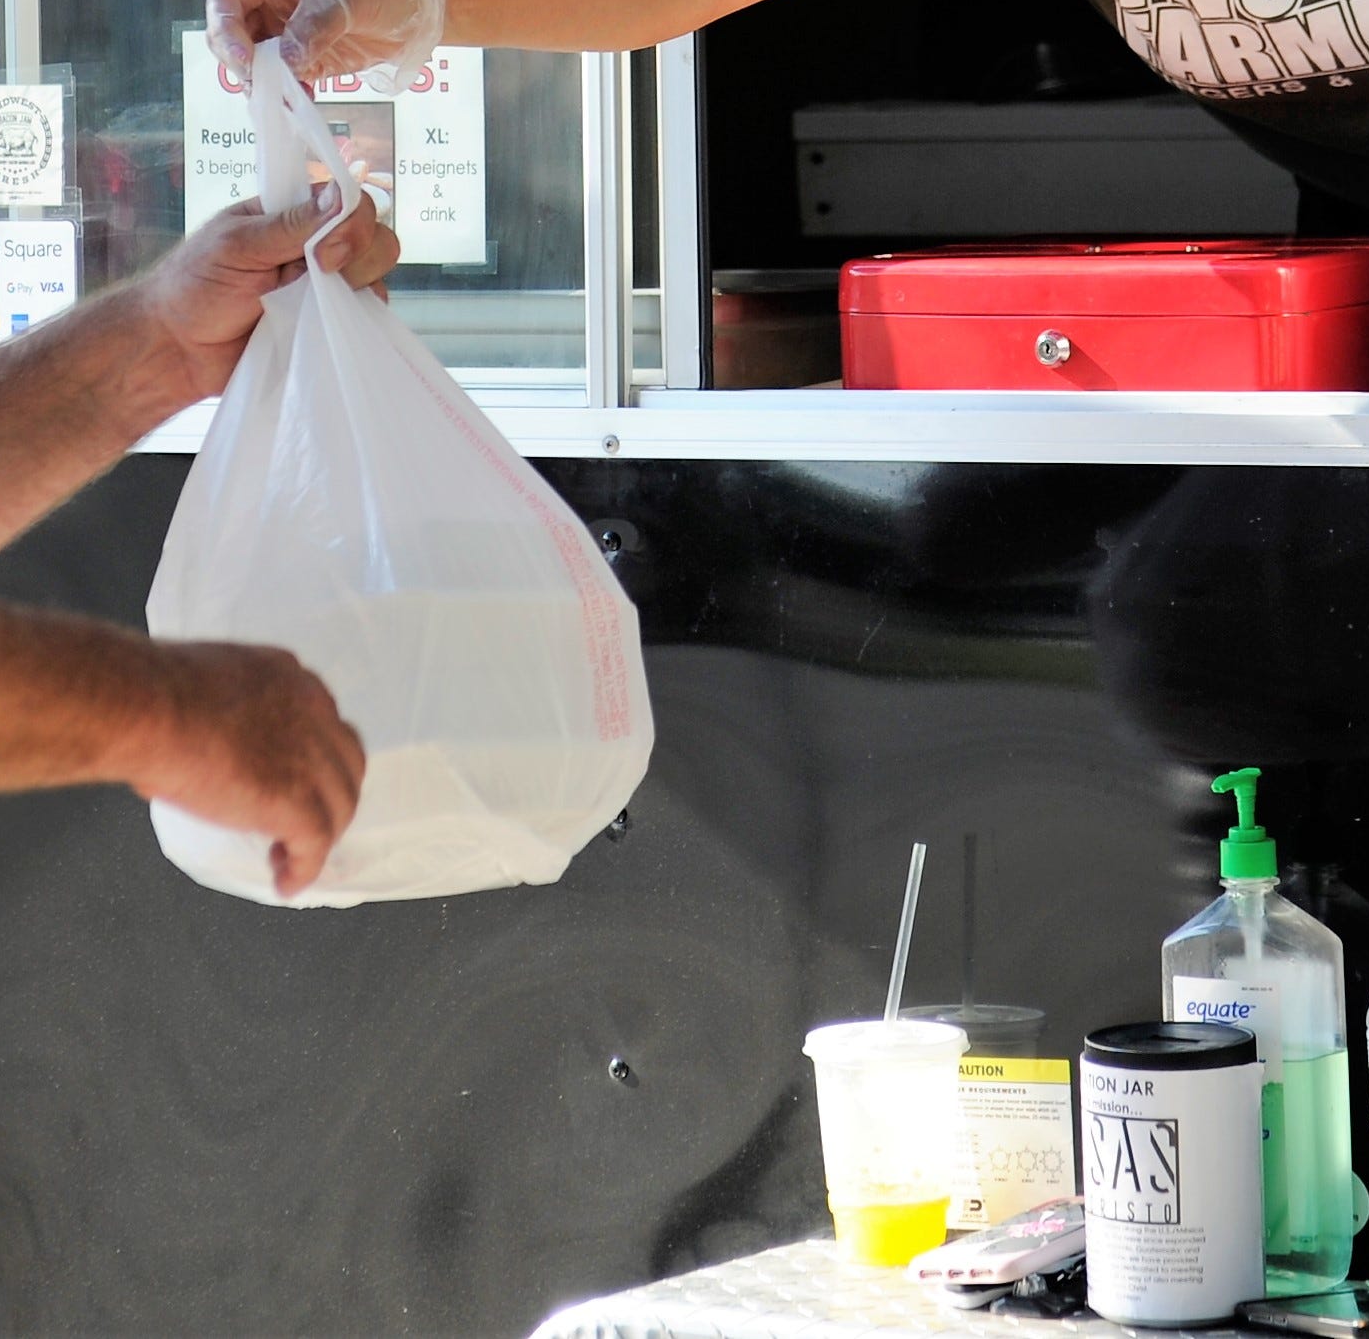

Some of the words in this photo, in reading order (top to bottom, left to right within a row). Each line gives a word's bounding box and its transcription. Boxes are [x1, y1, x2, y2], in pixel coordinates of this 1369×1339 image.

[426, 128, 450, 145] XL:
[196, 159, 205, 175] 3
[398, 159, 407, 175] 5
[410, 157, 478, 179] beignets
[230, 183, 241, 198] &
[432, 183, 444, 199] &
[419, 205, 457, 222] drink
[4, 239, 63, 262] Square
[40, 281, 64, 293] VISA
[1186, 1000, 1251, 1023] equate
[958, 1064, 1004, 1077] AUTION
[1122, 1079, 1155, 1097] JAR
